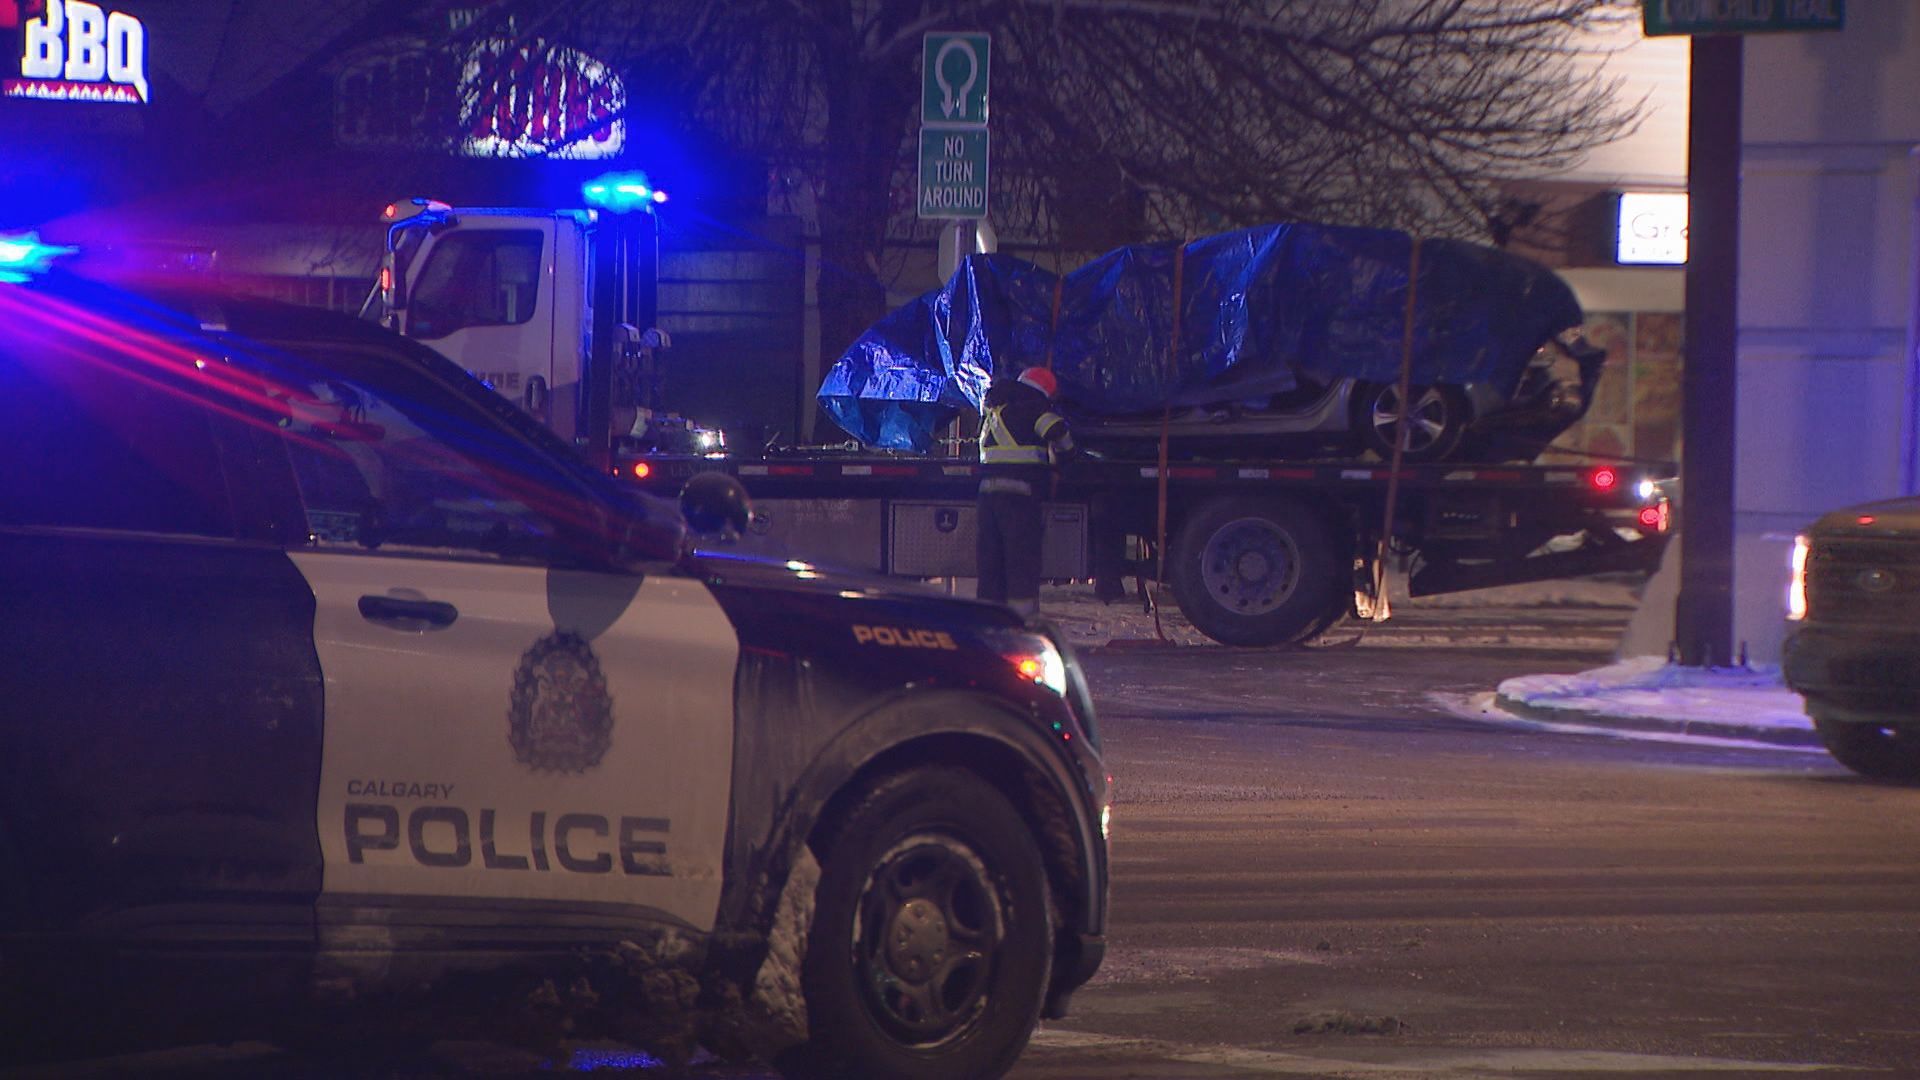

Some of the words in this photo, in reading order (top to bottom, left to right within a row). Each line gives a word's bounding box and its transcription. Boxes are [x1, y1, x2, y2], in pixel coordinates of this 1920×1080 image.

[21, 0, 148, 104] BBQ
[944, 136, 964, 158] NO
[935, 160, 973, 183] TURN
[923, 187, 983, 208] AROUND
[852, 624, 957, 650] POLICE
[347, 780, 454, 799] CALGARY
[344, 803, 673, 877] POLICE
